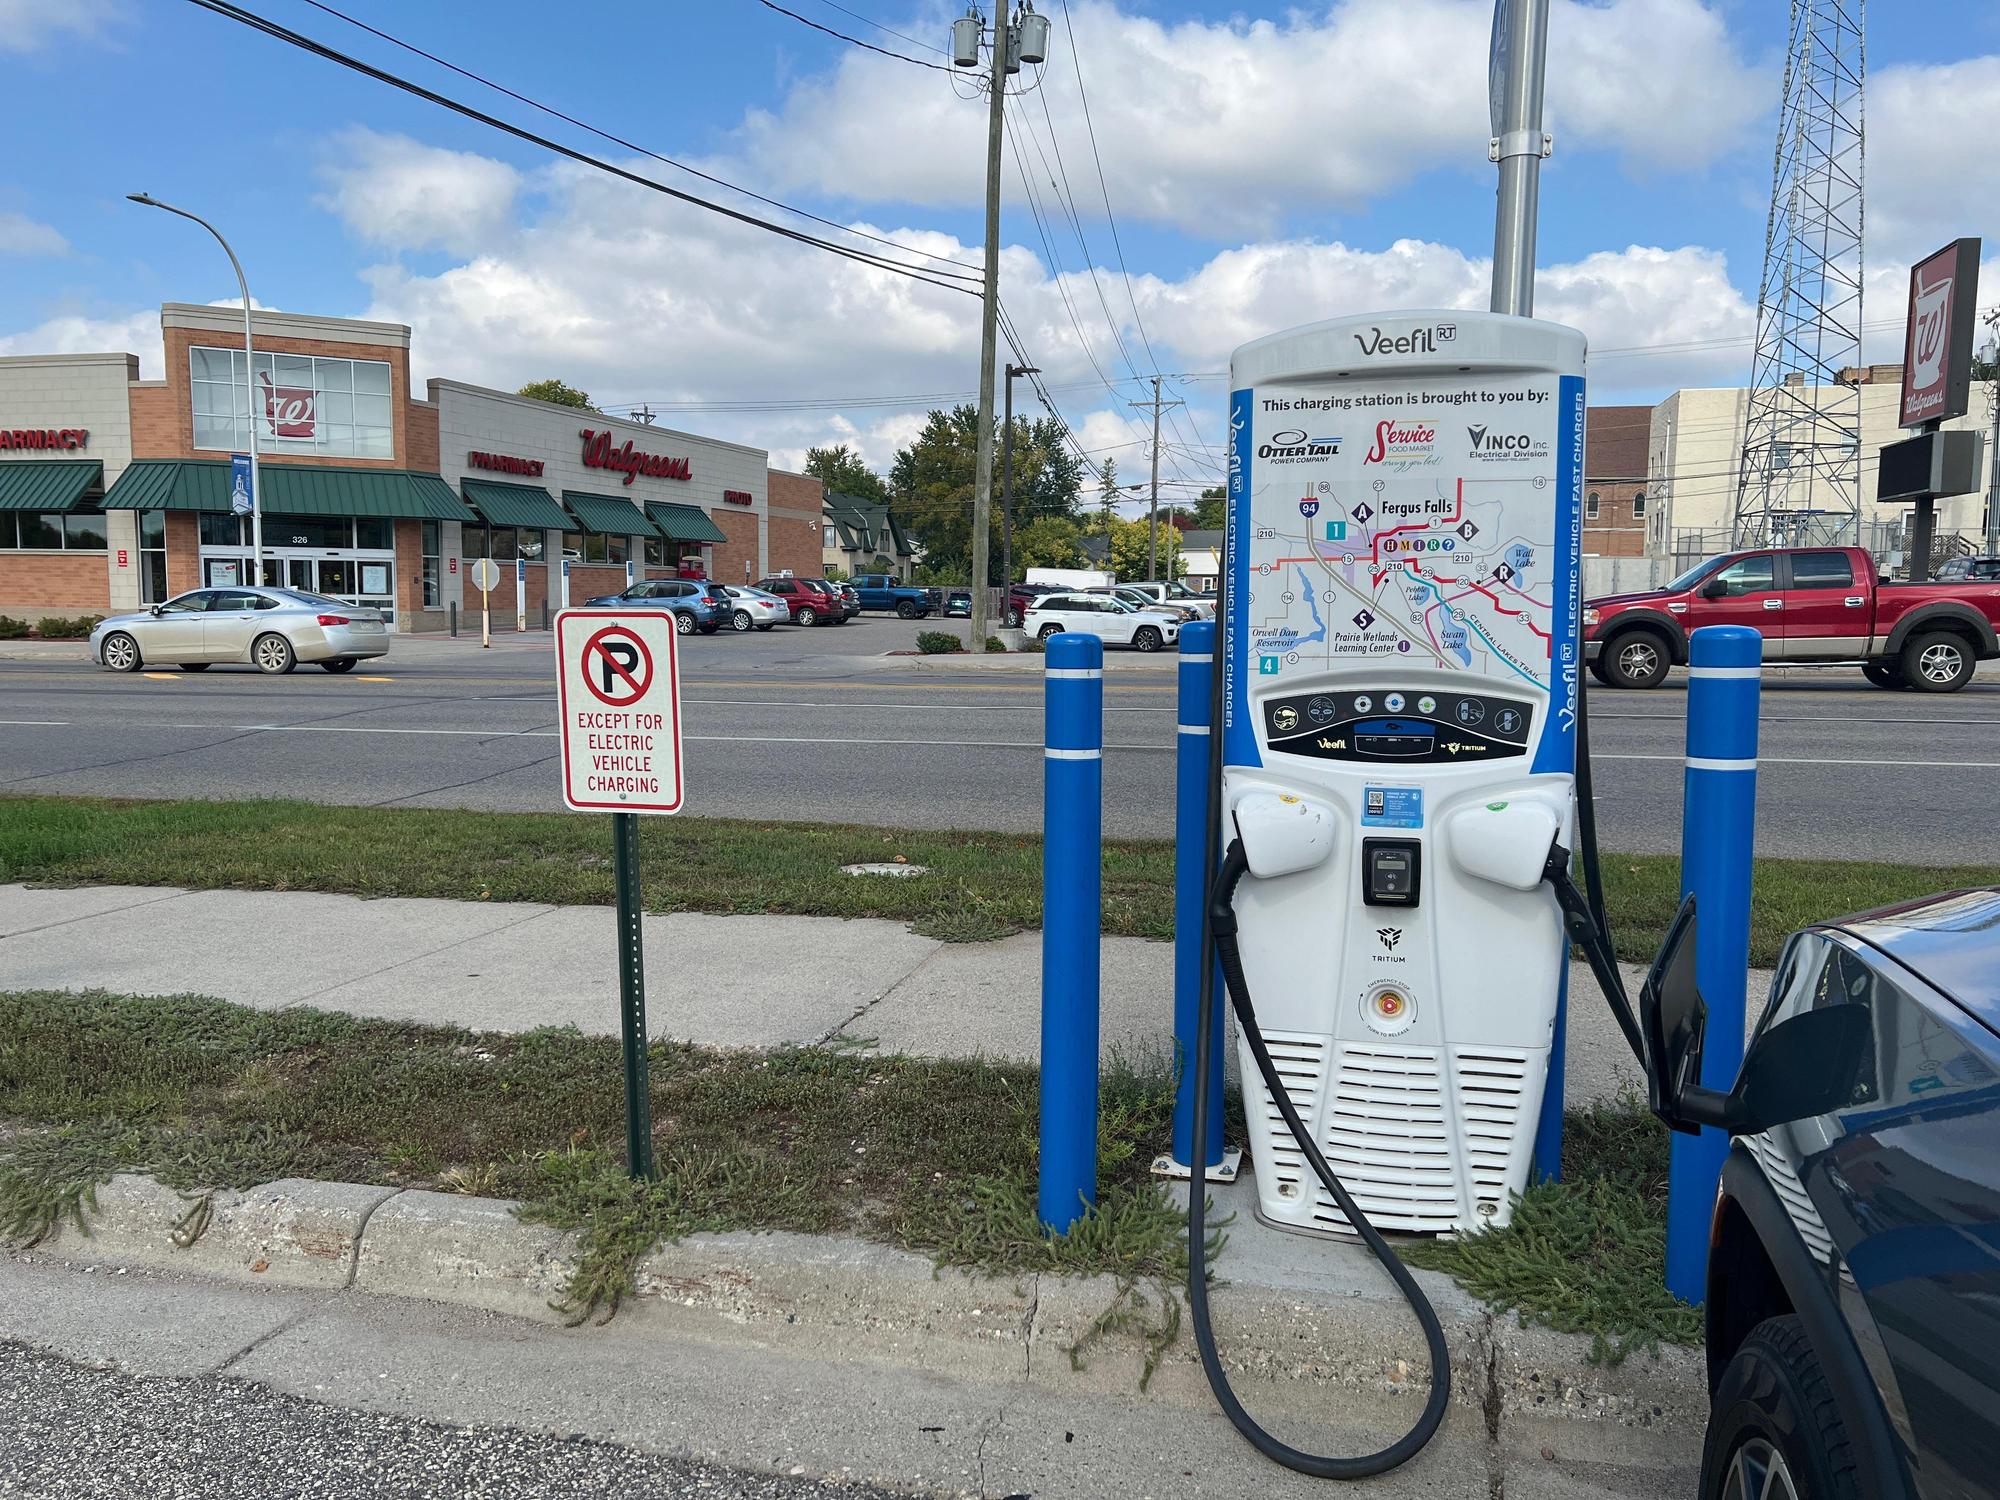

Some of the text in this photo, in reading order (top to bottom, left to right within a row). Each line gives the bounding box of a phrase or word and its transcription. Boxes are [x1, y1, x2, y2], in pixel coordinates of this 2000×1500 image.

[1353, 325, 1456, 356] Veefil RT
[1262, 388, 1549, 412] This charging station is brought to you by:
[1906, 389, 1944, 417] Walgreens
[1363, 419, 1435, 466] Service
[1466, 423, 1550, 450] VINCO inc.
[1388, 444, 1435, 453] FOOD MARKET
[1469, 450, 1548, 459] Electrical Division
[468, 450, 546, 478] PHARMACY
[580, 429, 693, 487] Walgreens
[1270, 455, 1330, 465] POWER COMPANY
[723, 489, 753, 506] PHOTO
[1302, 503, 1316, 514] 94
[1357, 504, 1368, 519] A
[1381, 498, 1453, 518] Fergus Falls
[1568, 392, 1584, 638] ELECTRIC VEHICLE FAST CHARGER
[1259, 530, 1273, 538] 210
[1463, 523, 1473, 539] B
[292, 535, 308, 544] 326
[1400, 540, 1411, 551] M
[1429, 540, 1437, 550] R
[1455, 554, 1470, 562] 210
[1515, 548, 1535, 558] Wall
[1370, 565, 1379, 573] 25
[1514, 558, 1536, 568] Lake
[1422, 569, 1433, 578] 29
[1499, 565, 1509, 580] R
[1457, 578, 1469, 586] 120
[1225, 499, 1237, 729] ELECTRIC VEHICLE FAST CHARGER
[1359, 612, 1367, 627] S
[1453, 611, 1464, 619] 29
[1519, 614, 1530, 622] 33
[1252, 628, 1299, 637] Orwell Dam
[1334, 631, 1398, 642] Prairie Wetlands
[1440, 630, 1465, 639] Swan
[1256, 639, 1295, 648] Reservoir
[1334, 642, 1395, 655] Learning Center
[1442, 640, 1464, 649] Lake
[1469, 614, 1540, 681] CENTRAL LAKES TRAIL
[601, 642, 639, 694] P
[1263, 658, 1273, 672] 4
[1558, 660, 1577, 733] Veefil
[578, 712, 663, 730] EXCEPT FOR
[588, 734, 654, 751] ELECTRIC
[1316, 737, 1347, 750] Veefil
[1461, 744, 1487, 752] TRITIUM
[592, 755, 652, 772] VEHICLE
[587, 775, 659, 793] CHARGING
[1372, 955, 1406, 963] TRITIUM
[1367, 978, 1411, 990] EMERGENCY STOP
[1367, 1024, 1380, 1035] TURN
[1388, 1027, 1410, 1038] RELEASE
